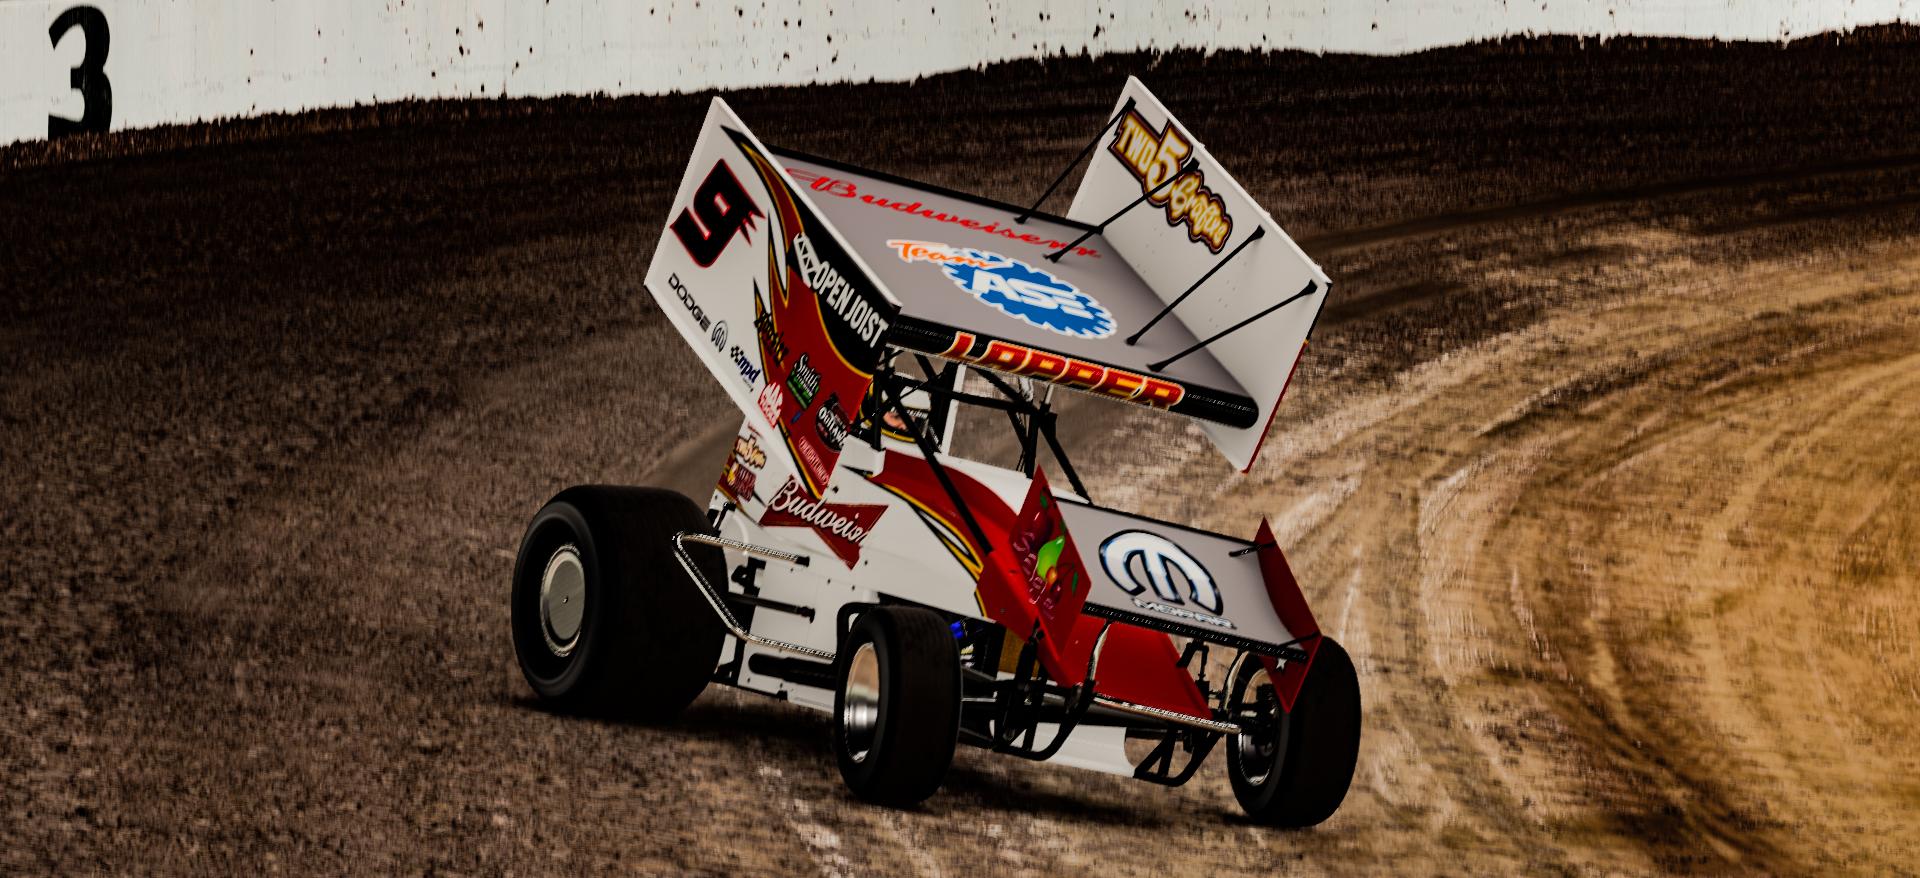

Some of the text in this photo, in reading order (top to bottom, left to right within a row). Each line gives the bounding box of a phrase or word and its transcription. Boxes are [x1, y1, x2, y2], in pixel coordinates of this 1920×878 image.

[48, 5, 112, 139] 3
[1114, 114, 1158, 175] TWO
[1146, 126, 1189, 201] 5
[670, 158, 766, 268] 9
[889, 240, 1010, 269] Team
[668, 272, 712, 333] DODGE
[812, 260, 853, 317] OPEN
[843, 295, 889, 348] JOIST
